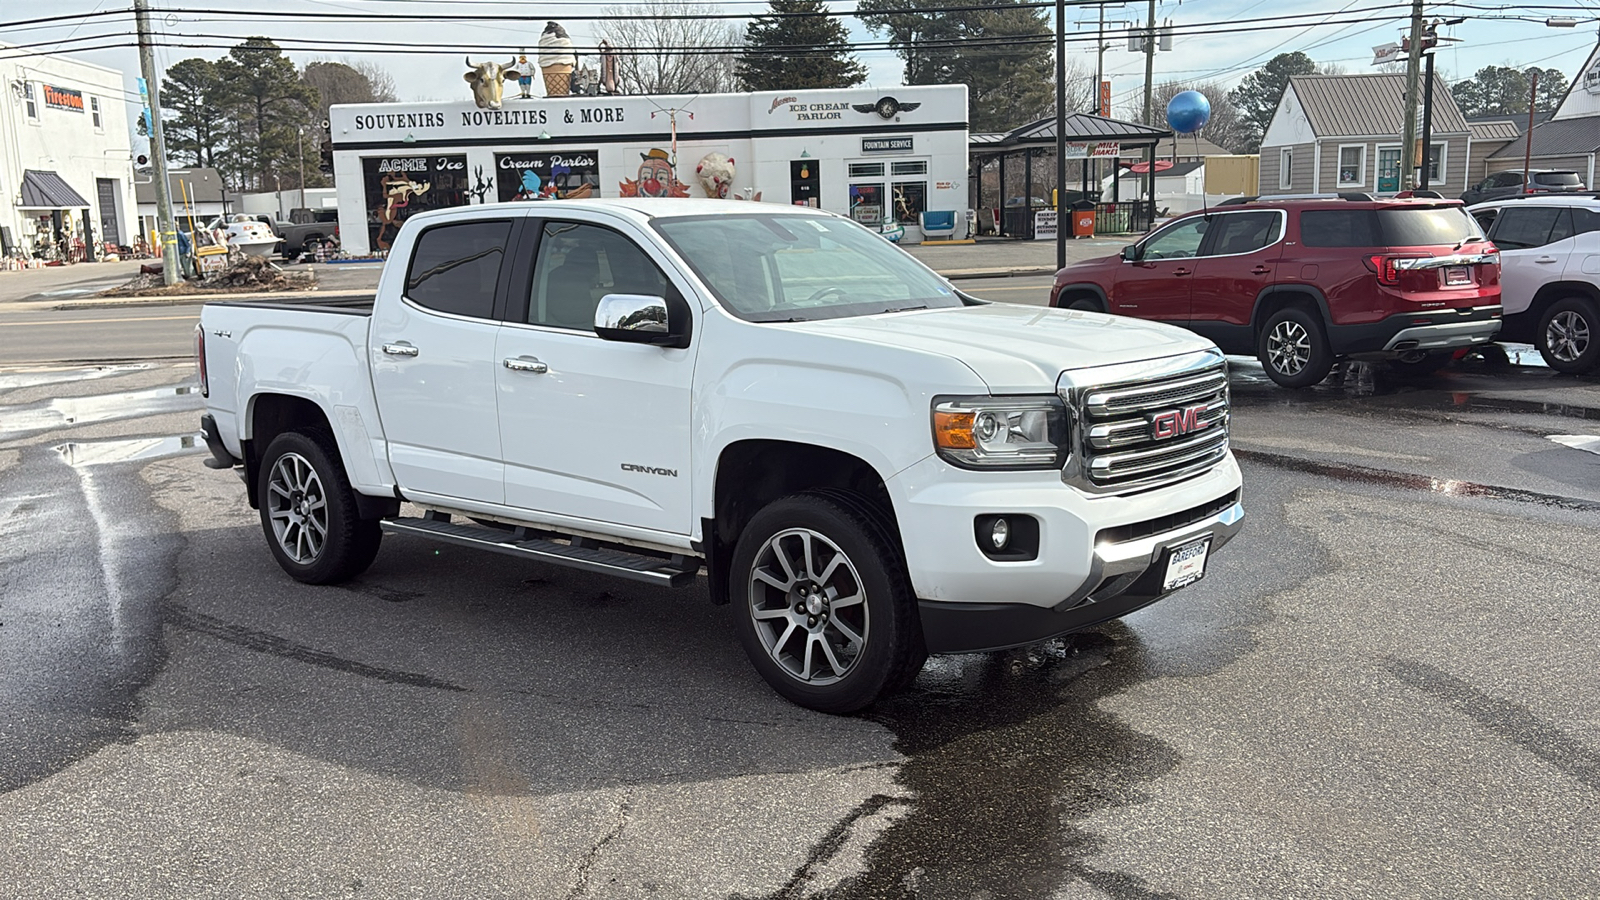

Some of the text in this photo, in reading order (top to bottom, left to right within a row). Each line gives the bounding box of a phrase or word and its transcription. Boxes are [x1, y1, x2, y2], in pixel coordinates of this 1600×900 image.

[43, 85, 84, 110] Firestone
[789, 102, 850, 112] ICE CREAM
[355, 107, 625, 130] SOUVENIRS NOVELTIES & MORE
[797, 112, 842, 121] PARLOR
[863, 139, 912, 150] FOUNTAIN SERVICE
[1092, 148, 1118, 157] SHAKES
[378, 154, 597, 173] ACME Ice Cream Parlor
[1153, 405, 1209, 440] GMC
[620, 463, 678, 478] CANYON
[1171, 545, 1205, 566] BAREFORD
